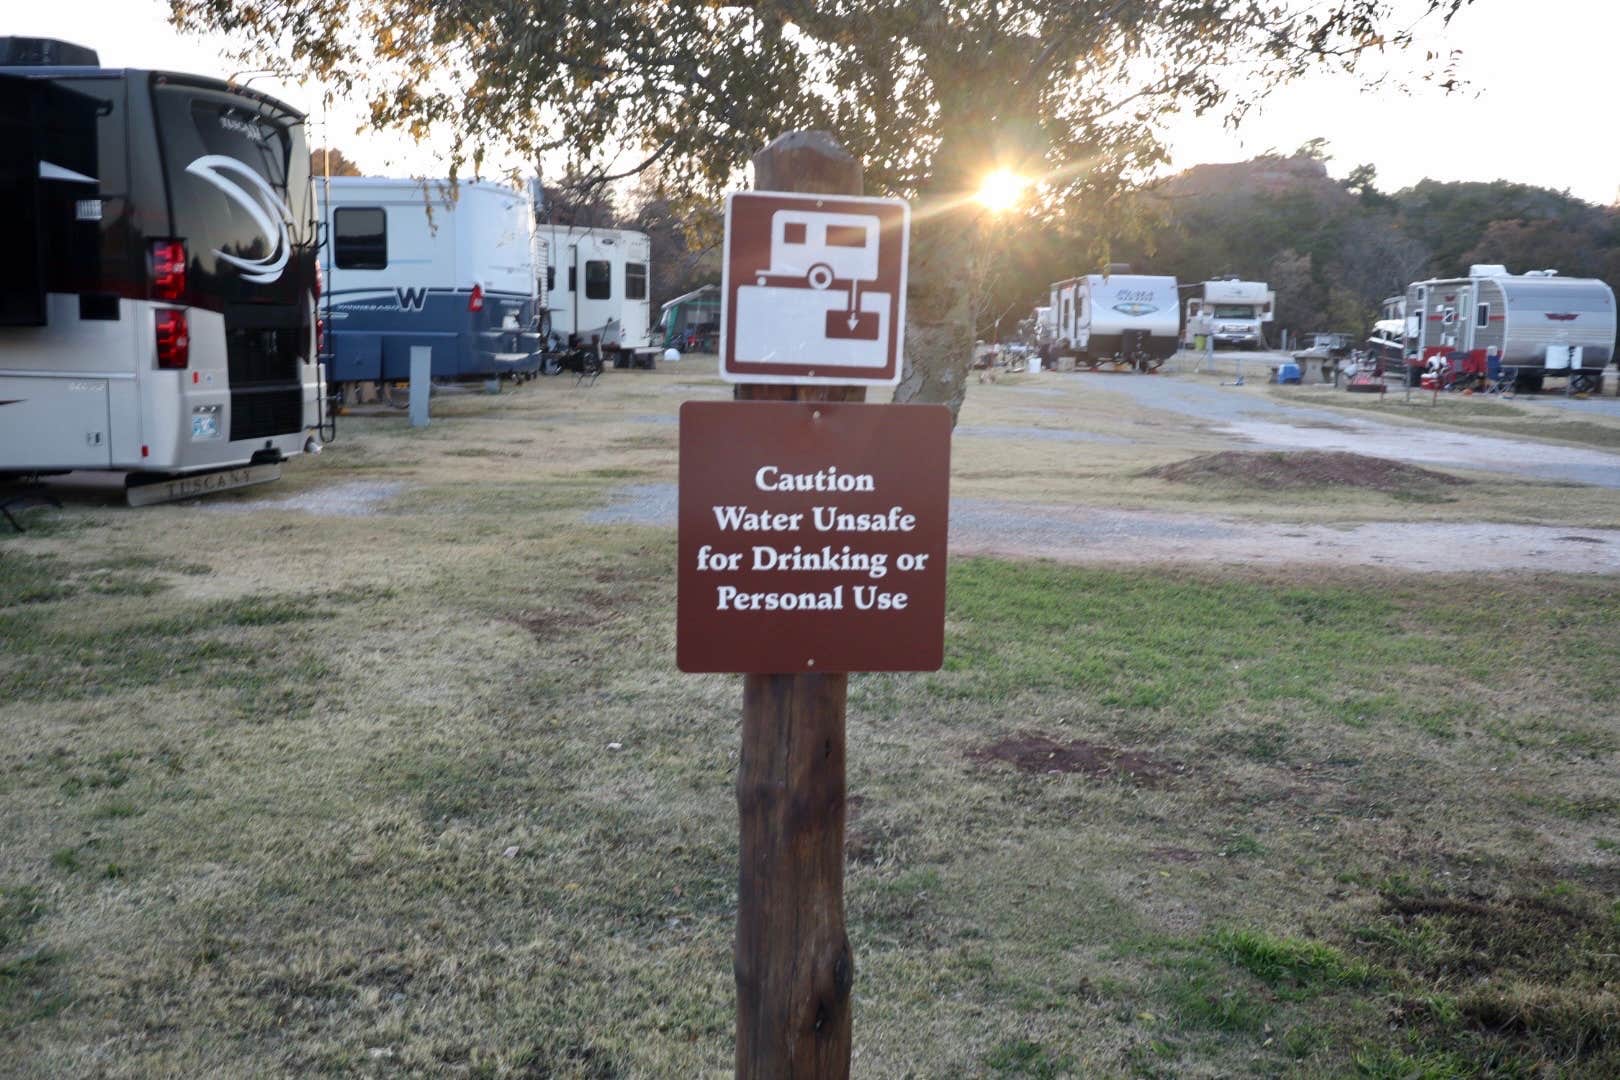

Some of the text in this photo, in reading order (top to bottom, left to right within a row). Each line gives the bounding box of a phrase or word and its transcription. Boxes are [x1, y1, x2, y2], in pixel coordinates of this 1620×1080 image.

[755, 465, 875, 492] Caution
[712, 506, 916, 532] Water Unsafe
[697, 545, 929, 578] for Drinking or
[716, 585, 908, 610] Personal Use
